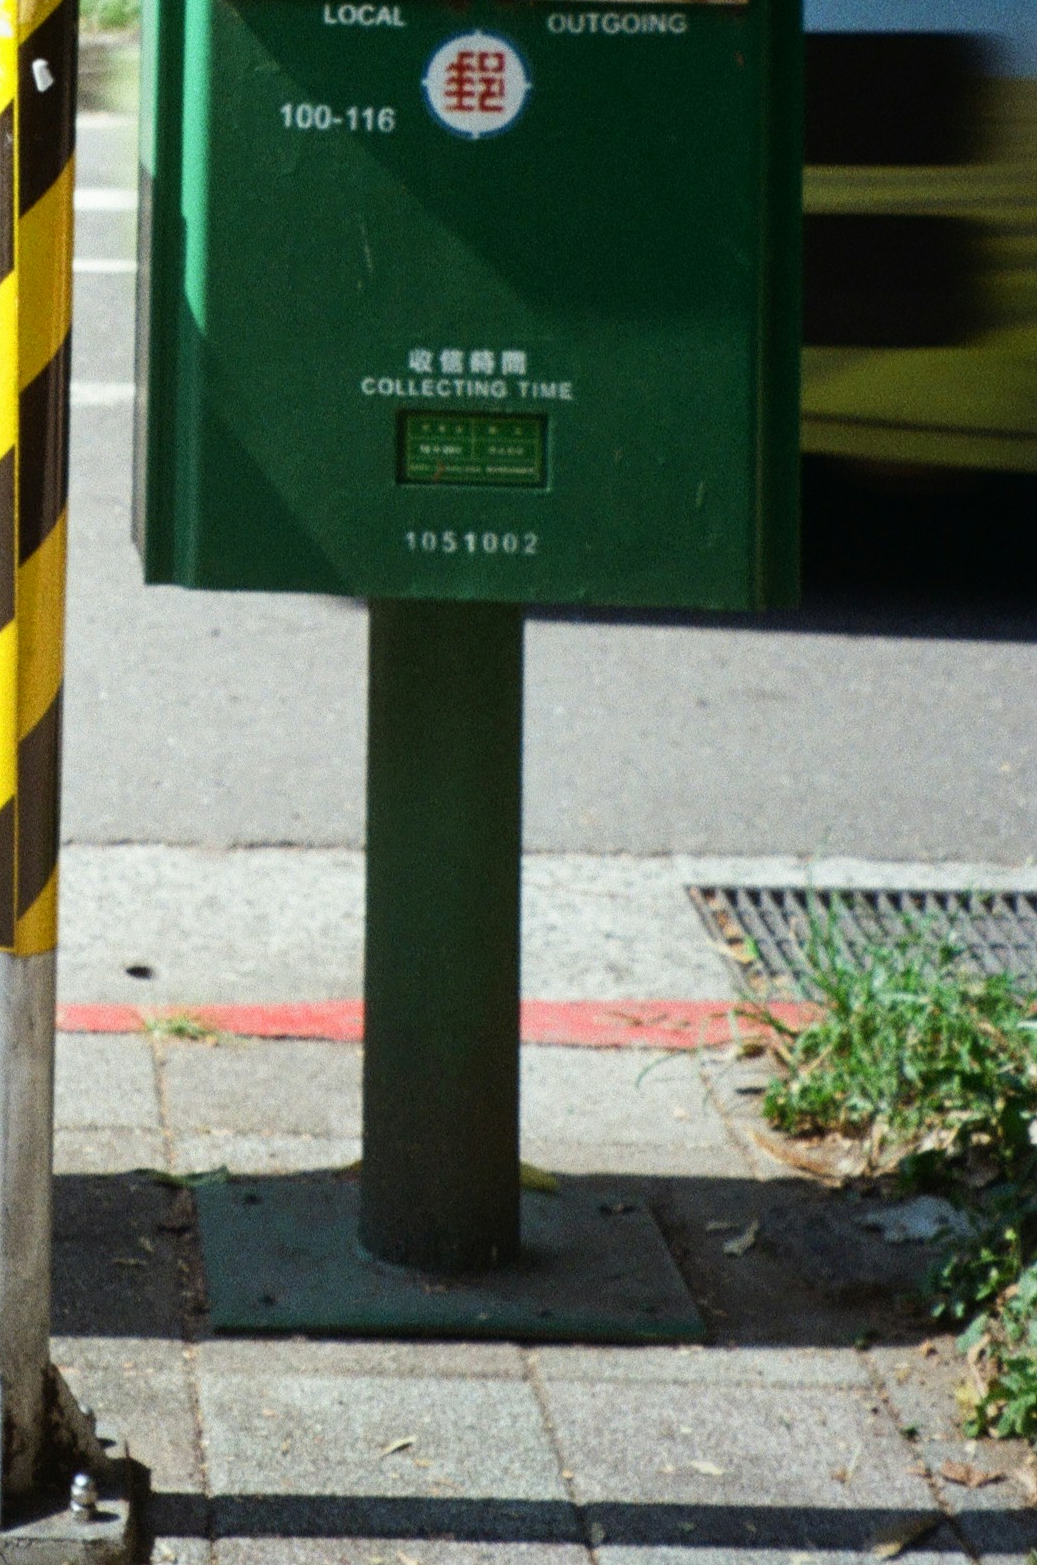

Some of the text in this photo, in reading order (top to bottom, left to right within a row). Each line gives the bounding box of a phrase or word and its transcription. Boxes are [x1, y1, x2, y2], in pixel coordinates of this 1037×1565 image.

[322, 3, 405, 28] LOCAL
[546, 11, 687, 35] OUTGOING
[279, 102, 396, 133] 100-116
[408, 349, 528, 375] 收信時間
[360, 377, 574, 401] COLLECTING TIME
[405, 529, 539, 555] 1051002
